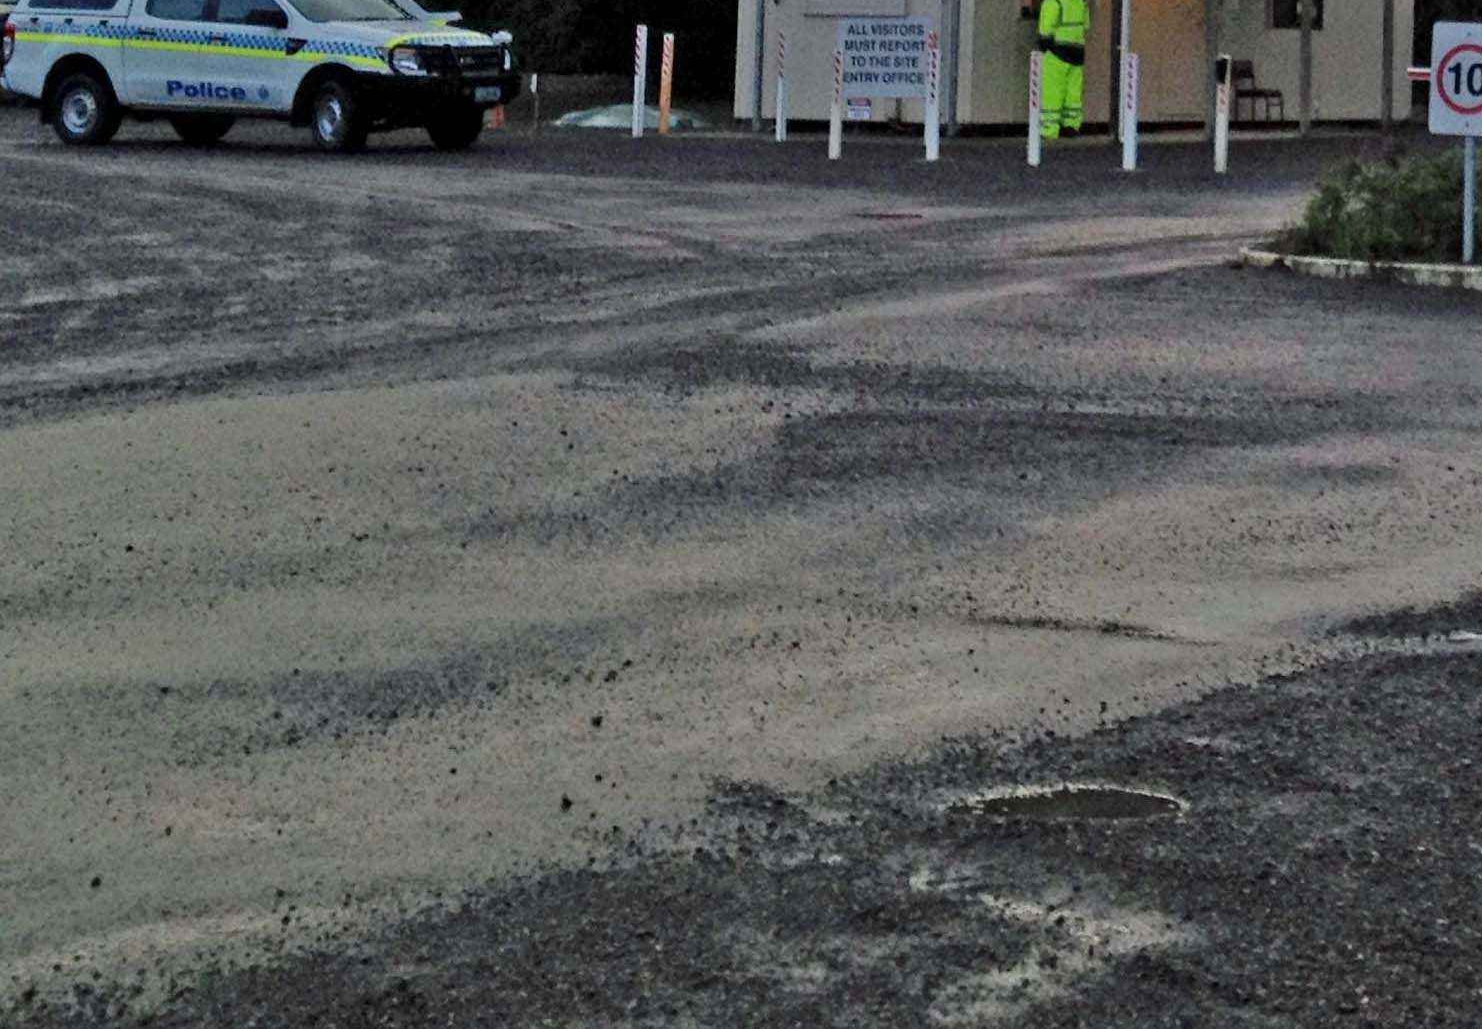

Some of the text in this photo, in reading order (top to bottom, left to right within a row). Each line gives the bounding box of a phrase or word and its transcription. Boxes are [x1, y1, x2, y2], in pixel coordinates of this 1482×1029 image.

[848, 25, 925, 36] ALL VISITORS
[845, 40, 926, 51] MUST REPORT
[851, 56, 918, 68] TO THE SITE
[843, 73, 925, 85] ENTRY OFFICE
[166, 80, 246, 99] Police
